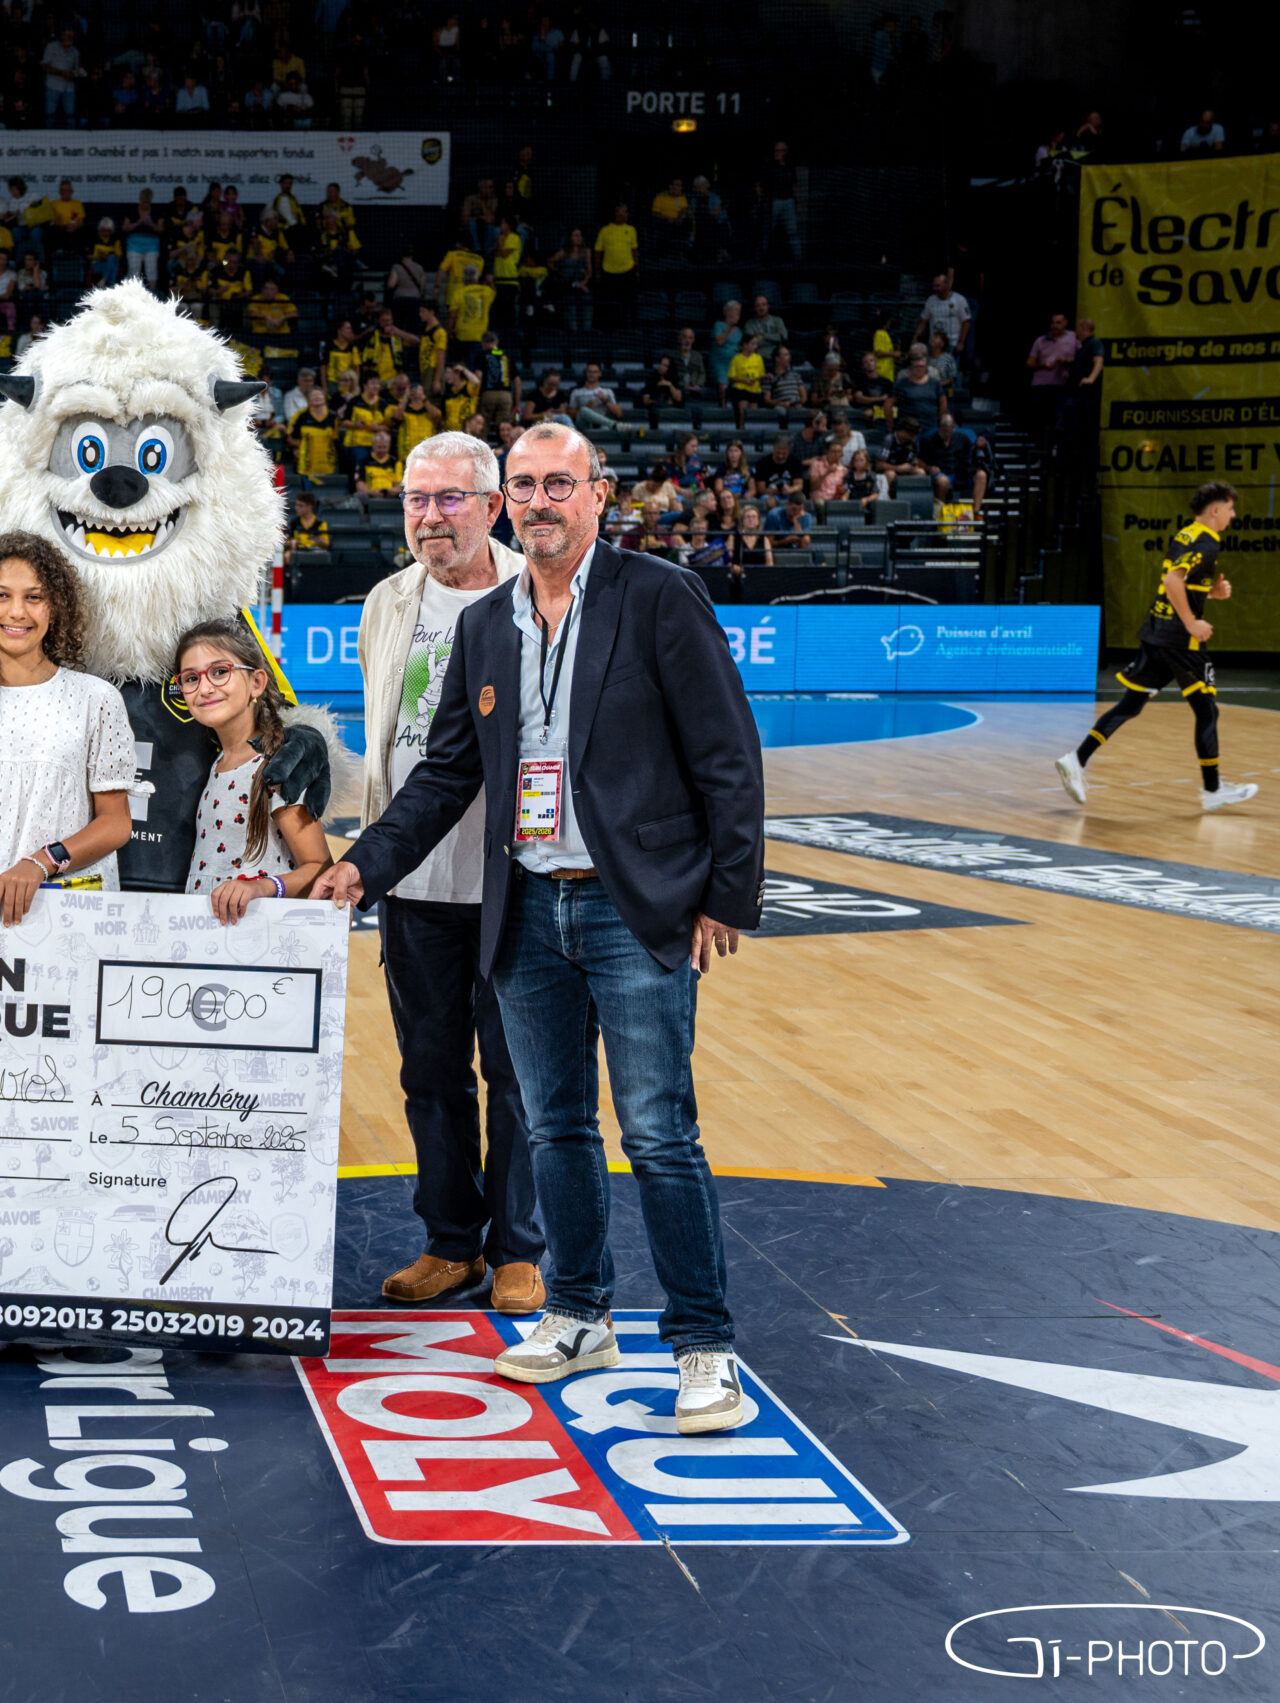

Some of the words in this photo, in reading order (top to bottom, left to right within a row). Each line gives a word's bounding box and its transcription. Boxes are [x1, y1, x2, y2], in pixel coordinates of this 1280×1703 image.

[625, 90, 706, 115] PORTE
[716, 90, 741, 115] 11
[61, 146, 85, 158] Team
[129, 147, 139, 158] et
[142, 149, 159, 160] pas
[172, 147, 202, 158] match
[205, 149, 225, 158] sans
[228, 148, 278, 160] supporters
[282, 147, 315, 159] fondus
[1088, 262, 1124, 288] de
[1110, 340, 1196, 362] L'énergie
[1199, 338, 1226, 360] de
[1229, 340, 1267, 357] nos
[1122, 405, 1235, 426] FOURNISSEUR
[1098, 443, 1215, 473] LOCALE
[1225, 443, 1265, 471] ET
[1124, 514, 1171, 530] Pour
[1144, 537, 1163, 552] et
[412, 624, 442, 644] Pour
[936, 625, 987, 639] Poisson
[991, 624, 1032, 639] d'avril
[935, 643, 983, 657] Agence
[985, 642, 1084, 657] événementielle
[60, 893, 104, 912] JAUNE
[106, 903, 125, 918] ET
[94, 920, 128, 937] NOIR
[168, 914, 217, 931] SAVOIE
[90, 1090, 104, 1108] À
[140, 1080, 261, 1122] Chambéry
[30, 1116, 80, 1132] SAVOIE
[89, 1130, 108, 1145] Le
[119, 1115, 139, 1144] 5
[88, 1171, 168, 1190] Signature
[180, 1184, 252, 1205] CHAMBÉRY
[142, 1282, 214, 1301] CHAMBÉRY
[110, 1308, 246, 1337] 25032019
[252, 1315, 325, 1342] 2024
[322, 1321, 612, 1537] MOLY
